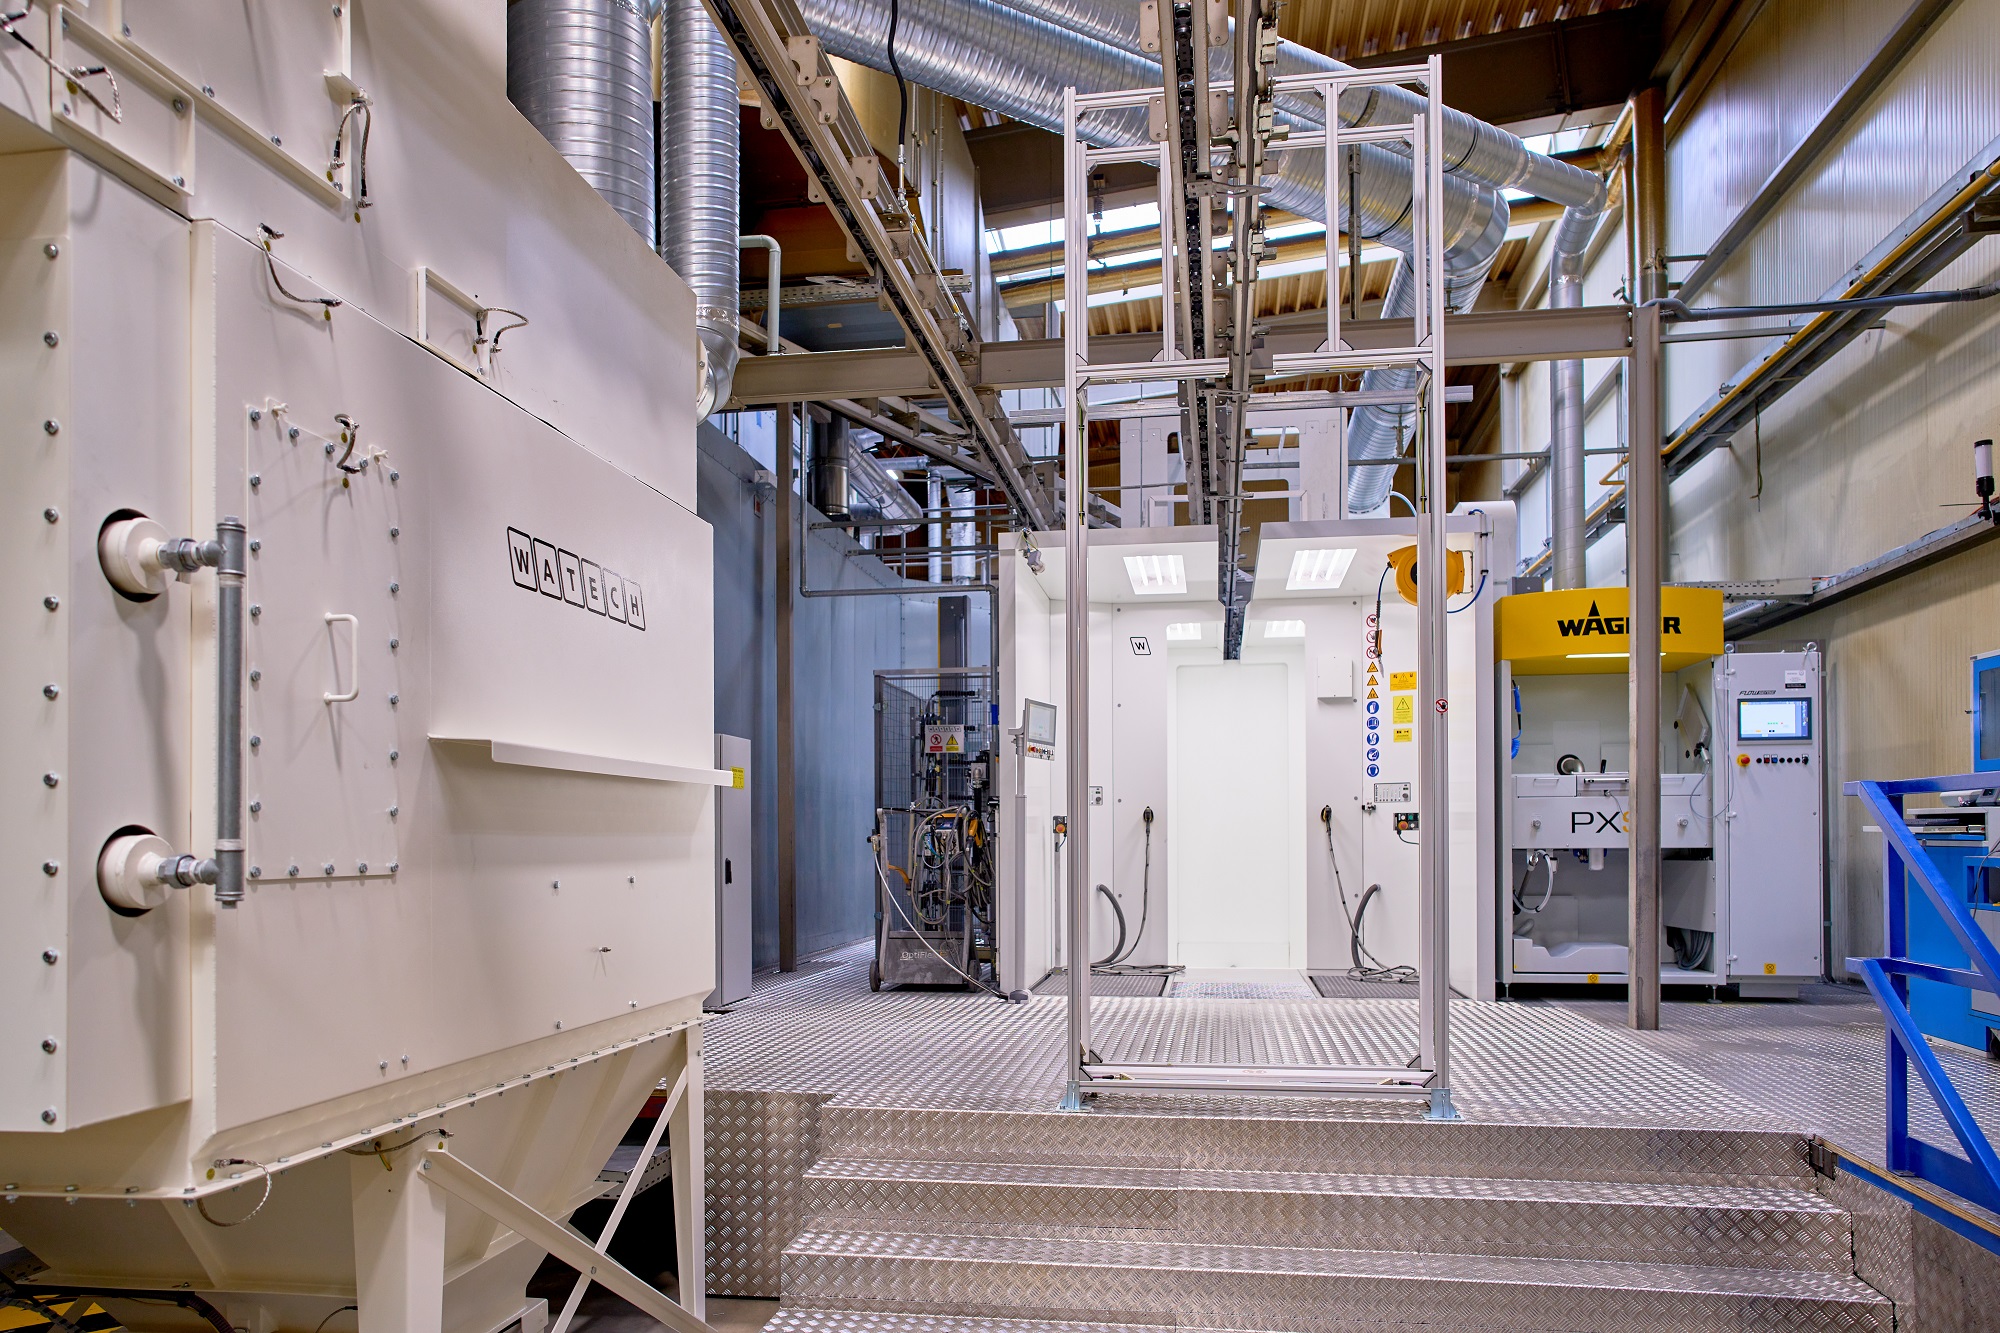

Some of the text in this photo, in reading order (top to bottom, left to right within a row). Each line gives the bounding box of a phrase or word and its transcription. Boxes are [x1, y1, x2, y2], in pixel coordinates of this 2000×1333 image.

[513, 545, 640, 617] WATECH
[1556, 616, 1682, 637] WAGR
[902, 951, 938, 960] OptiFle
